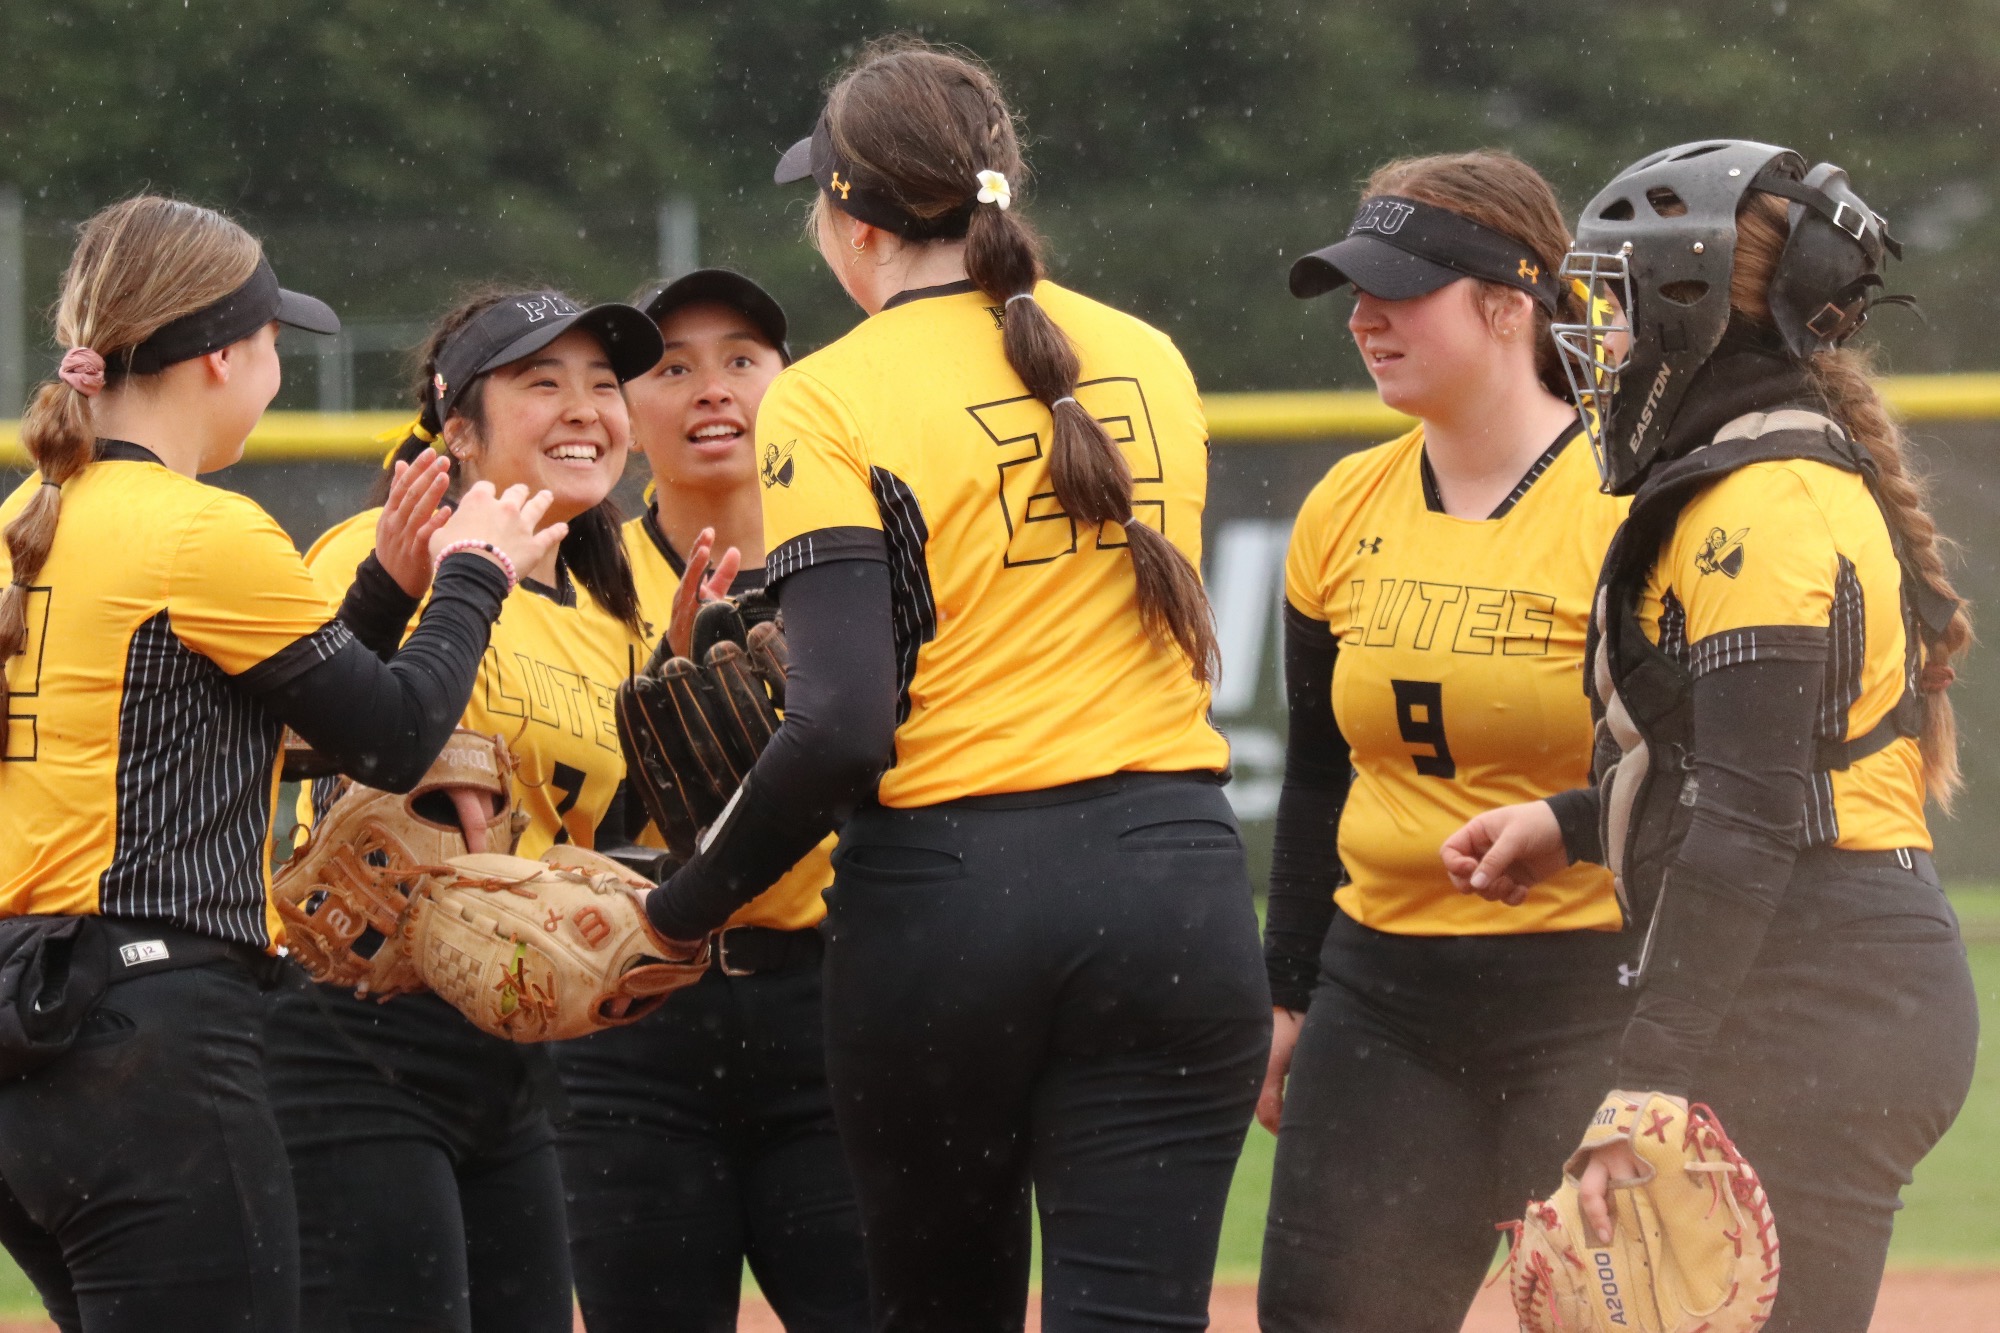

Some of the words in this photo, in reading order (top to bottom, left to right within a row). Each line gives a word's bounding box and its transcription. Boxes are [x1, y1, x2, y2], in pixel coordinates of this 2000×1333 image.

[516, 295, 577, 322] PL
[1629, 362, 1672, 455] EASTON
[1345, 578, 1557, 656] LUTES
[483, 645, 622, 756] LUTE
[1391, 679, 1456, 779] 9
[552, 760, 587, 845] 7
[1594, 1252, 1628, 1326] A2000
